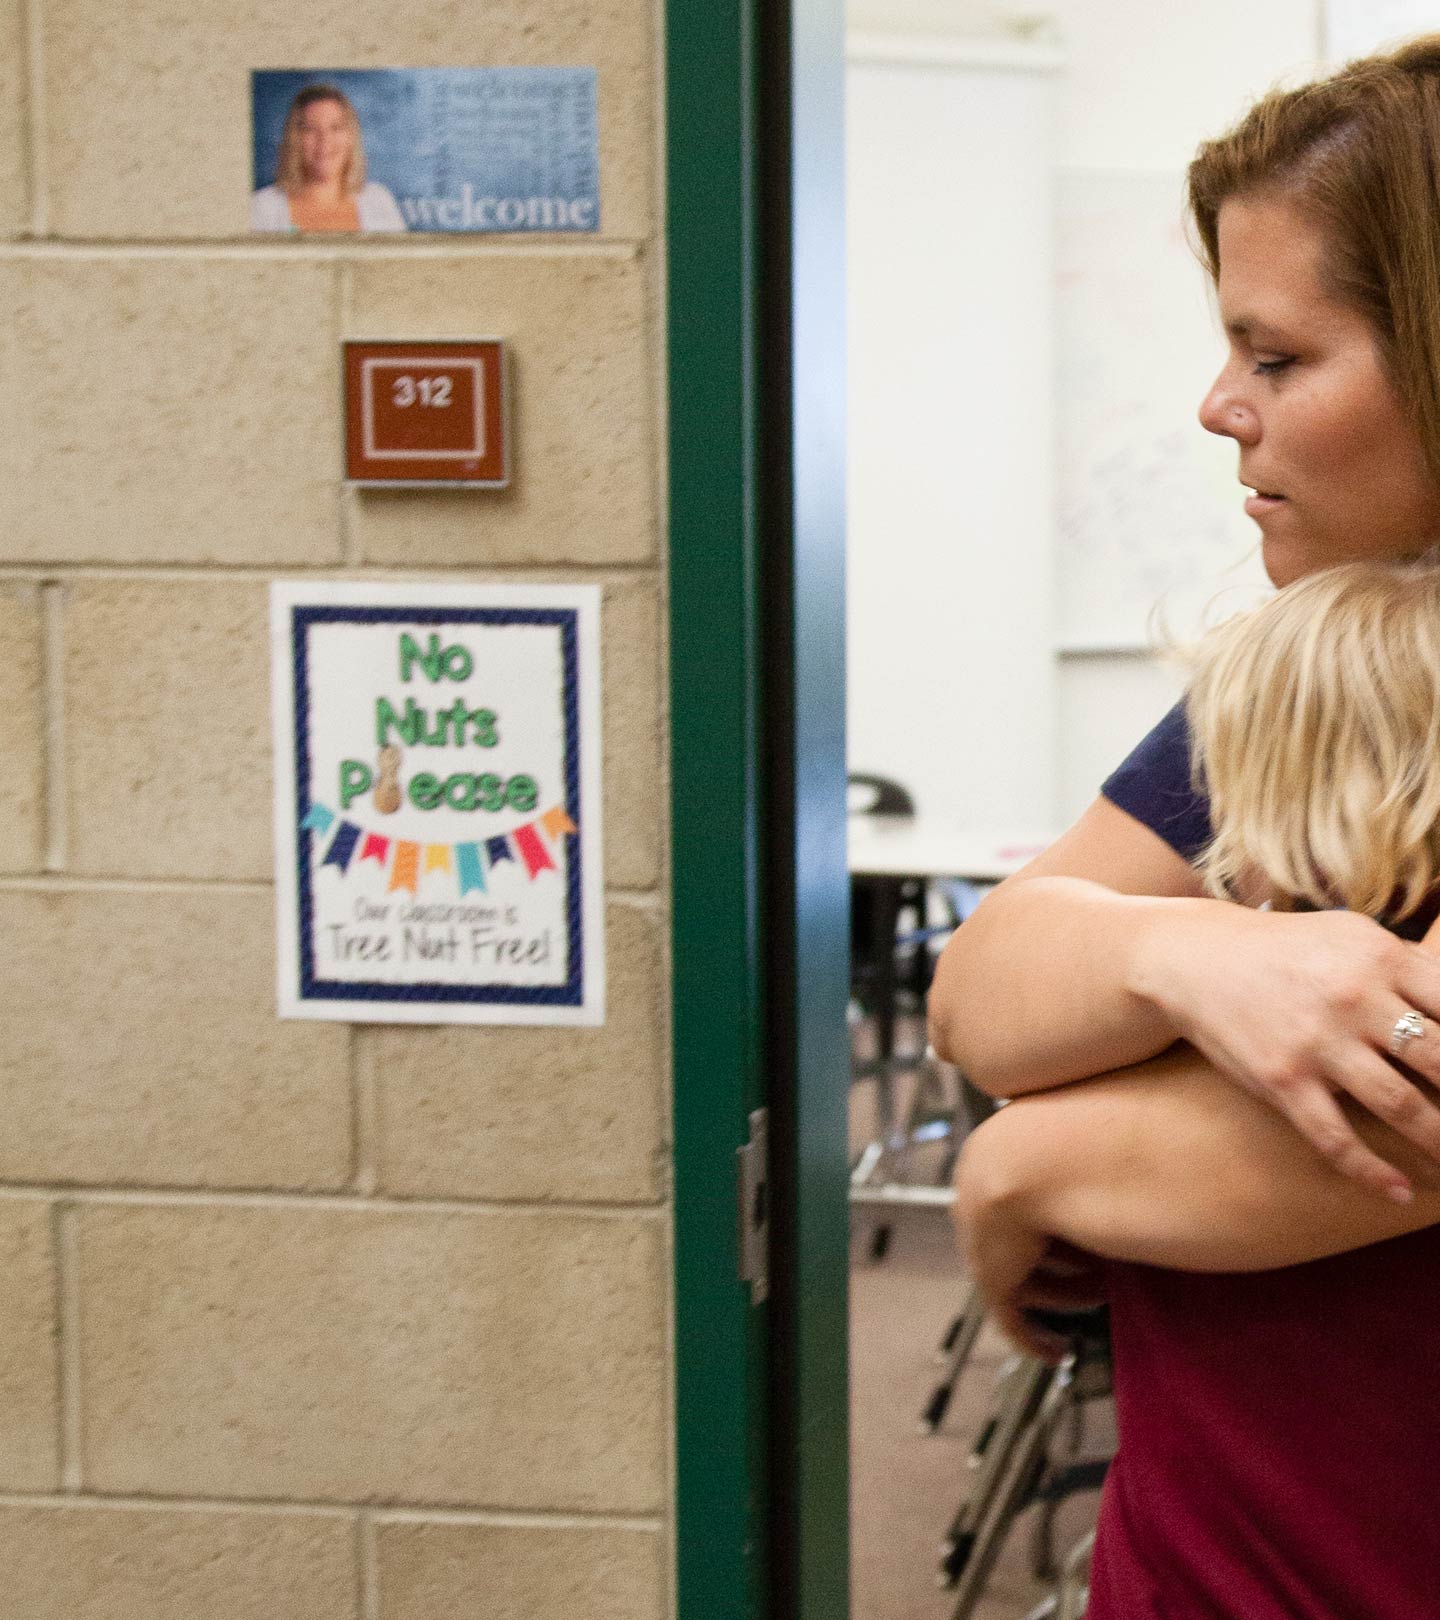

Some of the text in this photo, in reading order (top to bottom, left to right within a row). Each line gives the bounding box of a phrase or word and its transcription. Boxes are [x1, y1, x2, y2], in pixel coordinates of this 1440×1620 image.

[401, 182, 594, 228] welcome
[393, 375, 454, 408] 312
[399, 632, 474, 683] No
[375, 696, 499, 748] Nuts
[354, 897, 390, 922] Our
[327, 922, 391, 962] Tree
[401, 925, 461, 963] Nut
